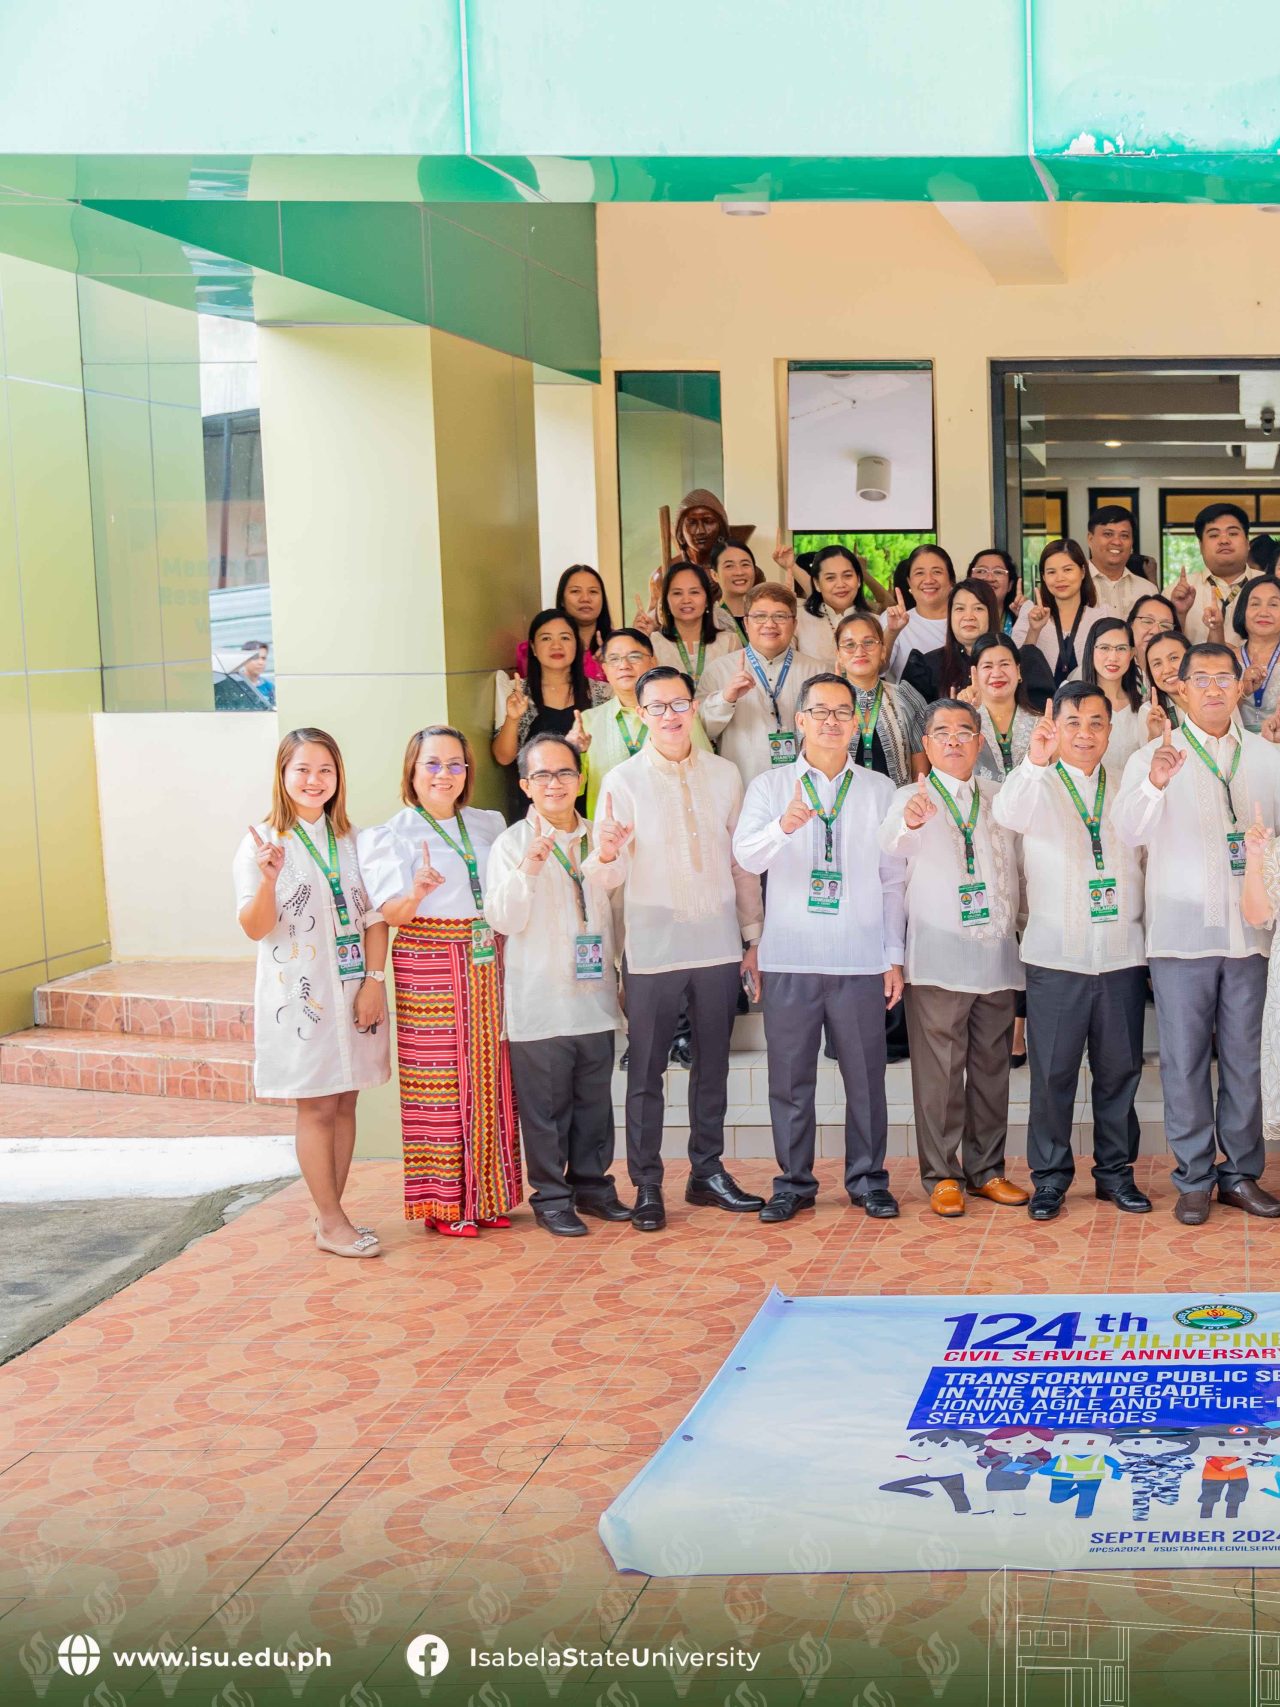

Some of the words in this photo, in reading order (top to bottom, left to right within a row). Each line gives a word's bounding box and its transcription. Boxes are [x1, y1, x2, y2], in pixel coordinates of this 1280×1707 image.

[944, 1311, 1088, 1350] 124
[1096, 1312, 1148, 1333] th
[943, 1350, 1001, 1362] CIVIL
[1012, 1349, 1115, 1362] SERVICE
[944, 1371, 1149, 1386] TRANSFORMING
[1156, 1370, 1248, 1384] PUBLIC
[936, 1386, 966, 1400] IN
[973, 1386, 1025, 1399] THE
[1030, 1386, 1104, 1399] NEXT
[1109, 1384, 1222, 1398] DECADE:
[931, 1399, 1025, 1411] HONING
[1030, 1399, 1103, 1411] AGILE
[1109, 1398, 1163, 1411] AND
[926, 1411, 1157, 1425] SERVANT-HEROES
[1090, 1530, 1225, 1544] SEPTEMBER
